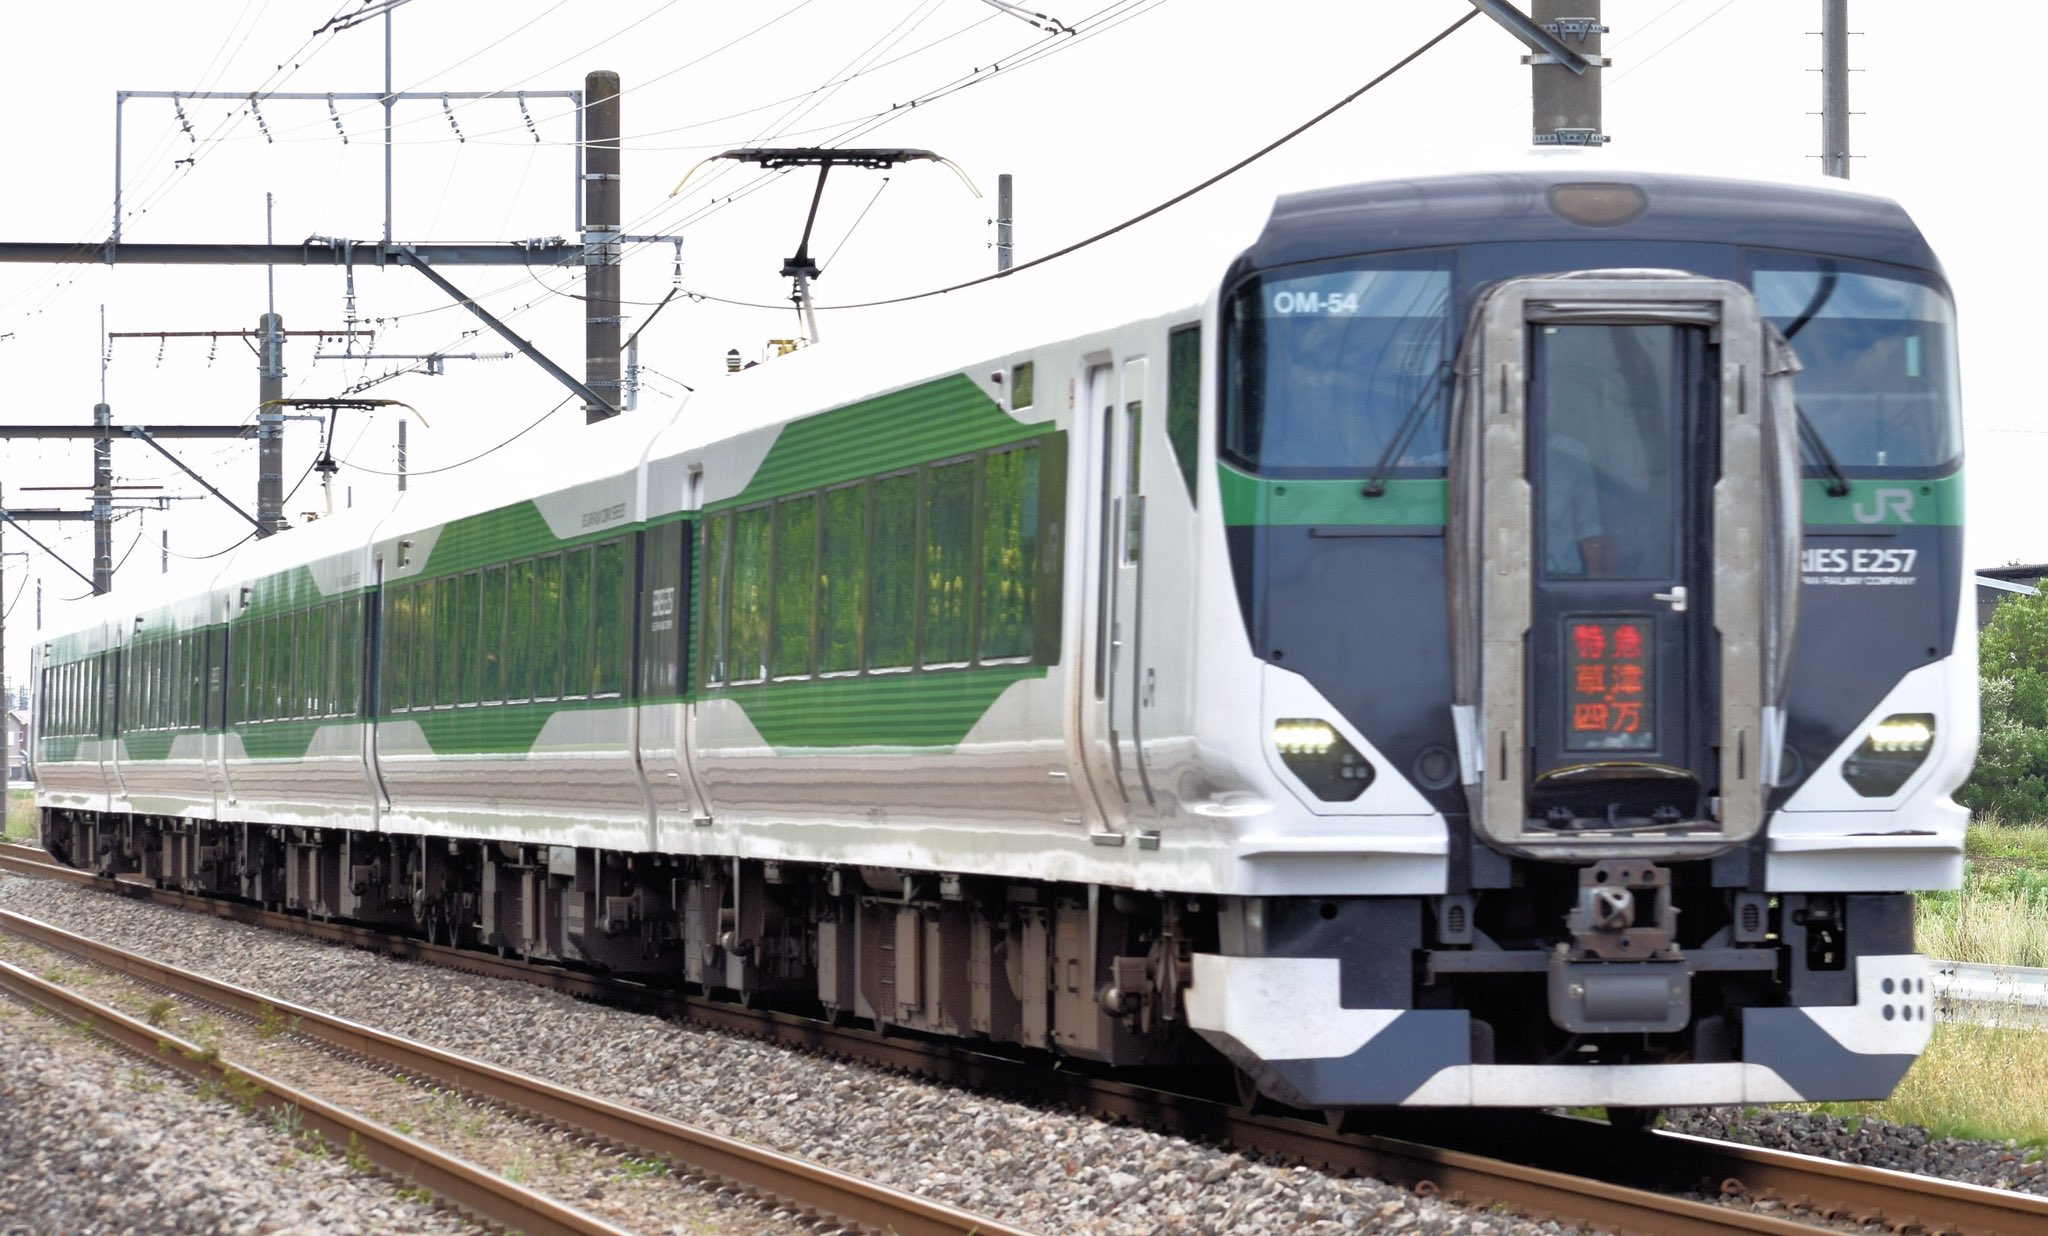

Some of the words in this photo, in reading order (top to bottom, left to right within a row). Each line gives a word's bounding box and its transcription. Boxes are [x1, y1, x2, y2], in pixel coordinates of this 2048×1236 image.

[1273, 291, 1359, 314] OM-54
[1852, 488, 1914, 523] JR
[1852, 548, 1918, 572] E257
[1573, 624, 1643, 658] 特急
